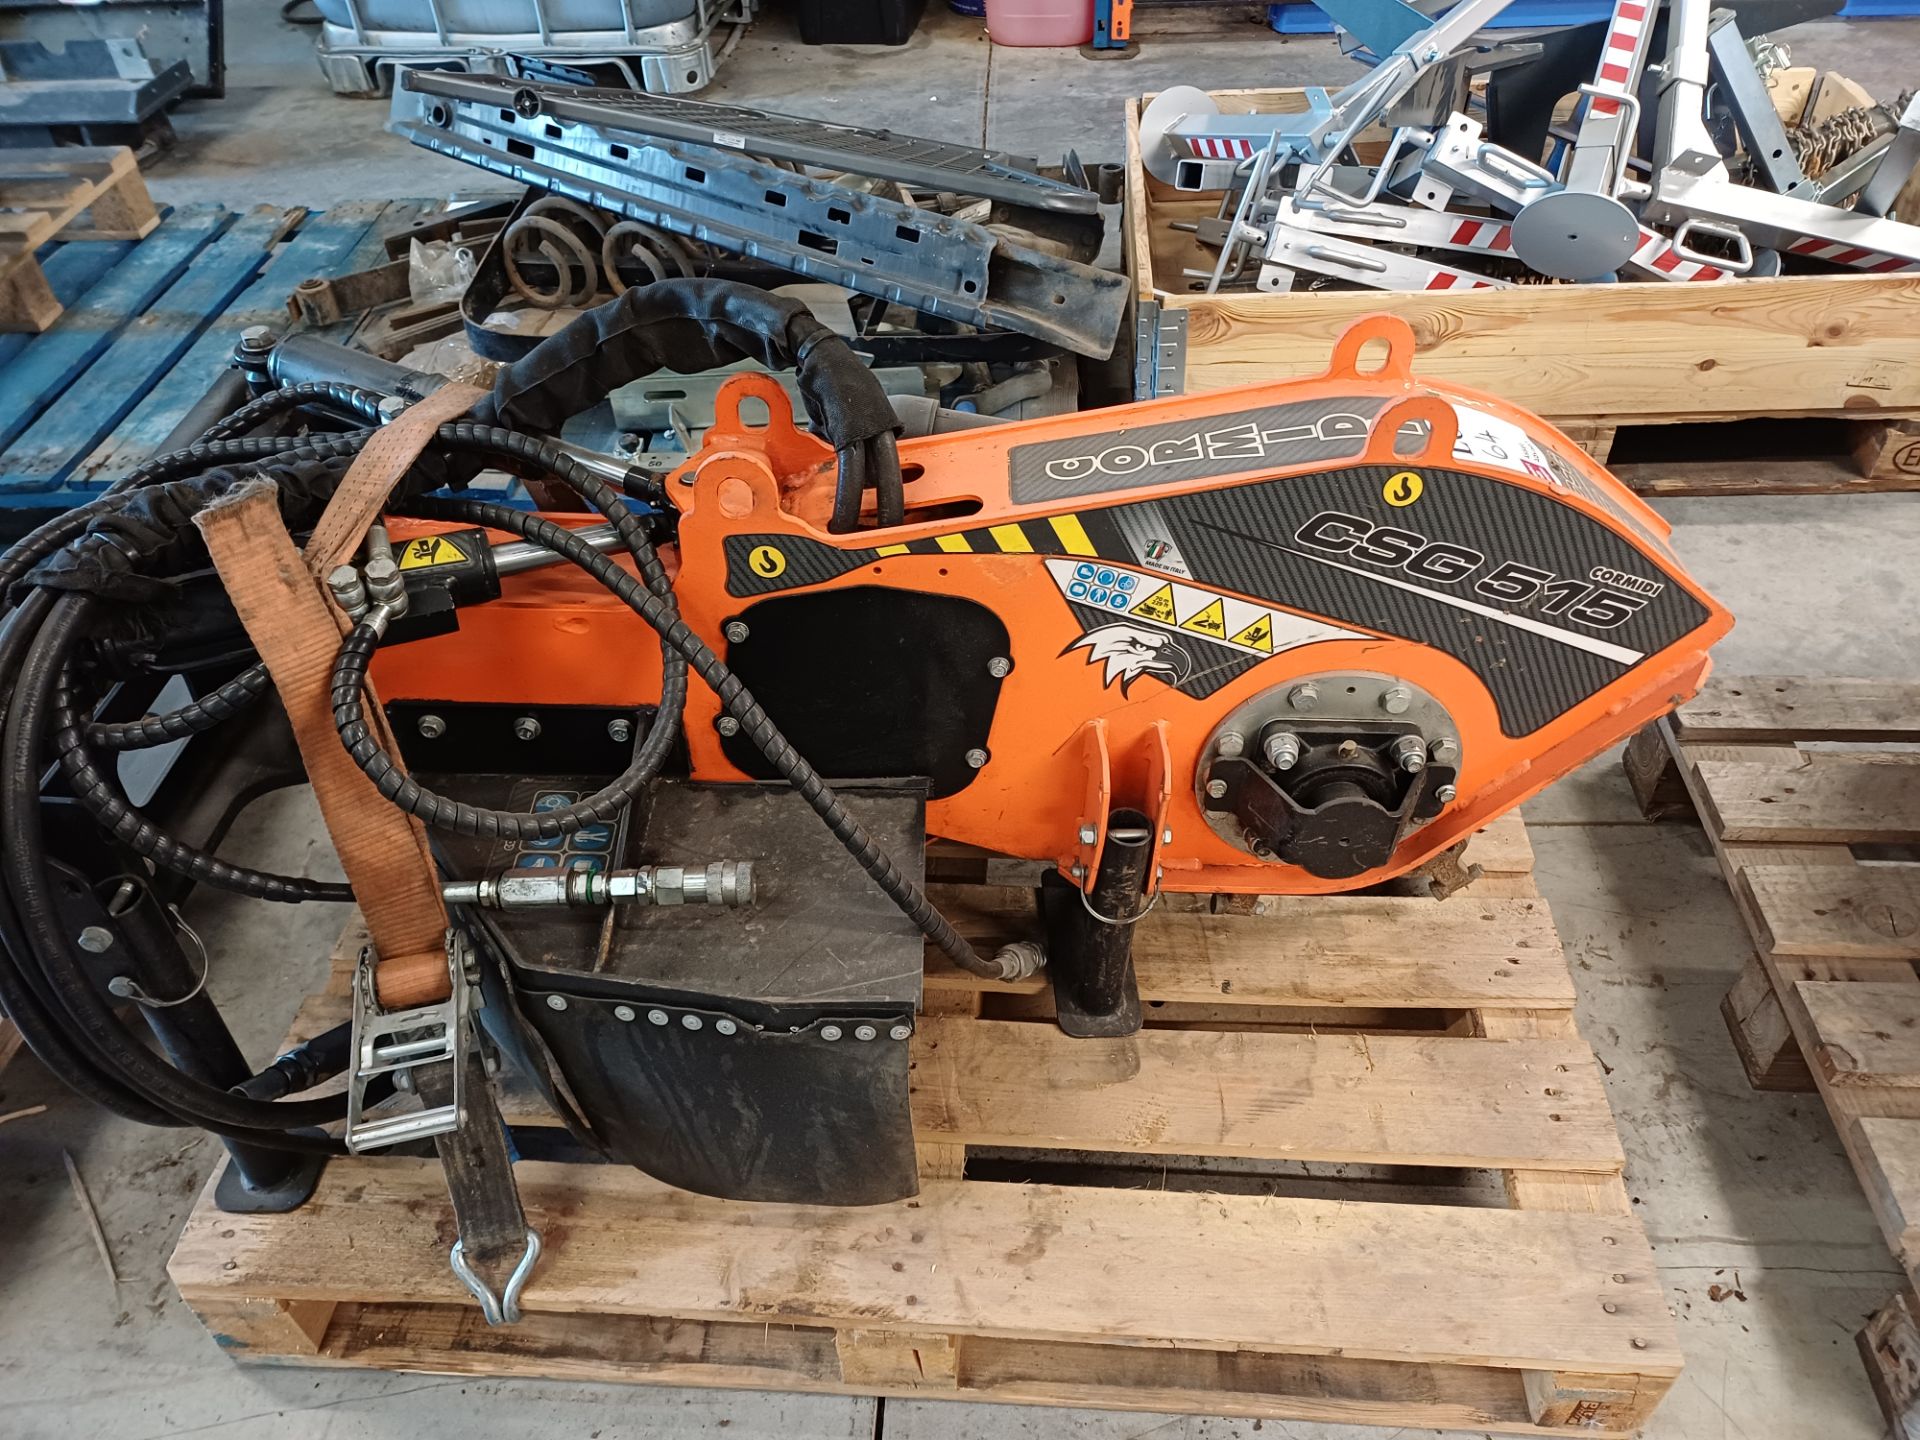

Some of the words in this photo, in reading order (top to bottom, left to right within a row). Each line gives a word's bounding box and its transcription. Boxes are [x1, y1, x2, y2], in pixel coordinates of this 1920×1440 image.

[1294, 511, 1485, 584] CSG
[1475, 561, 1649, 629] 515
[1589, 565, 1665, 598] CORMIDI
